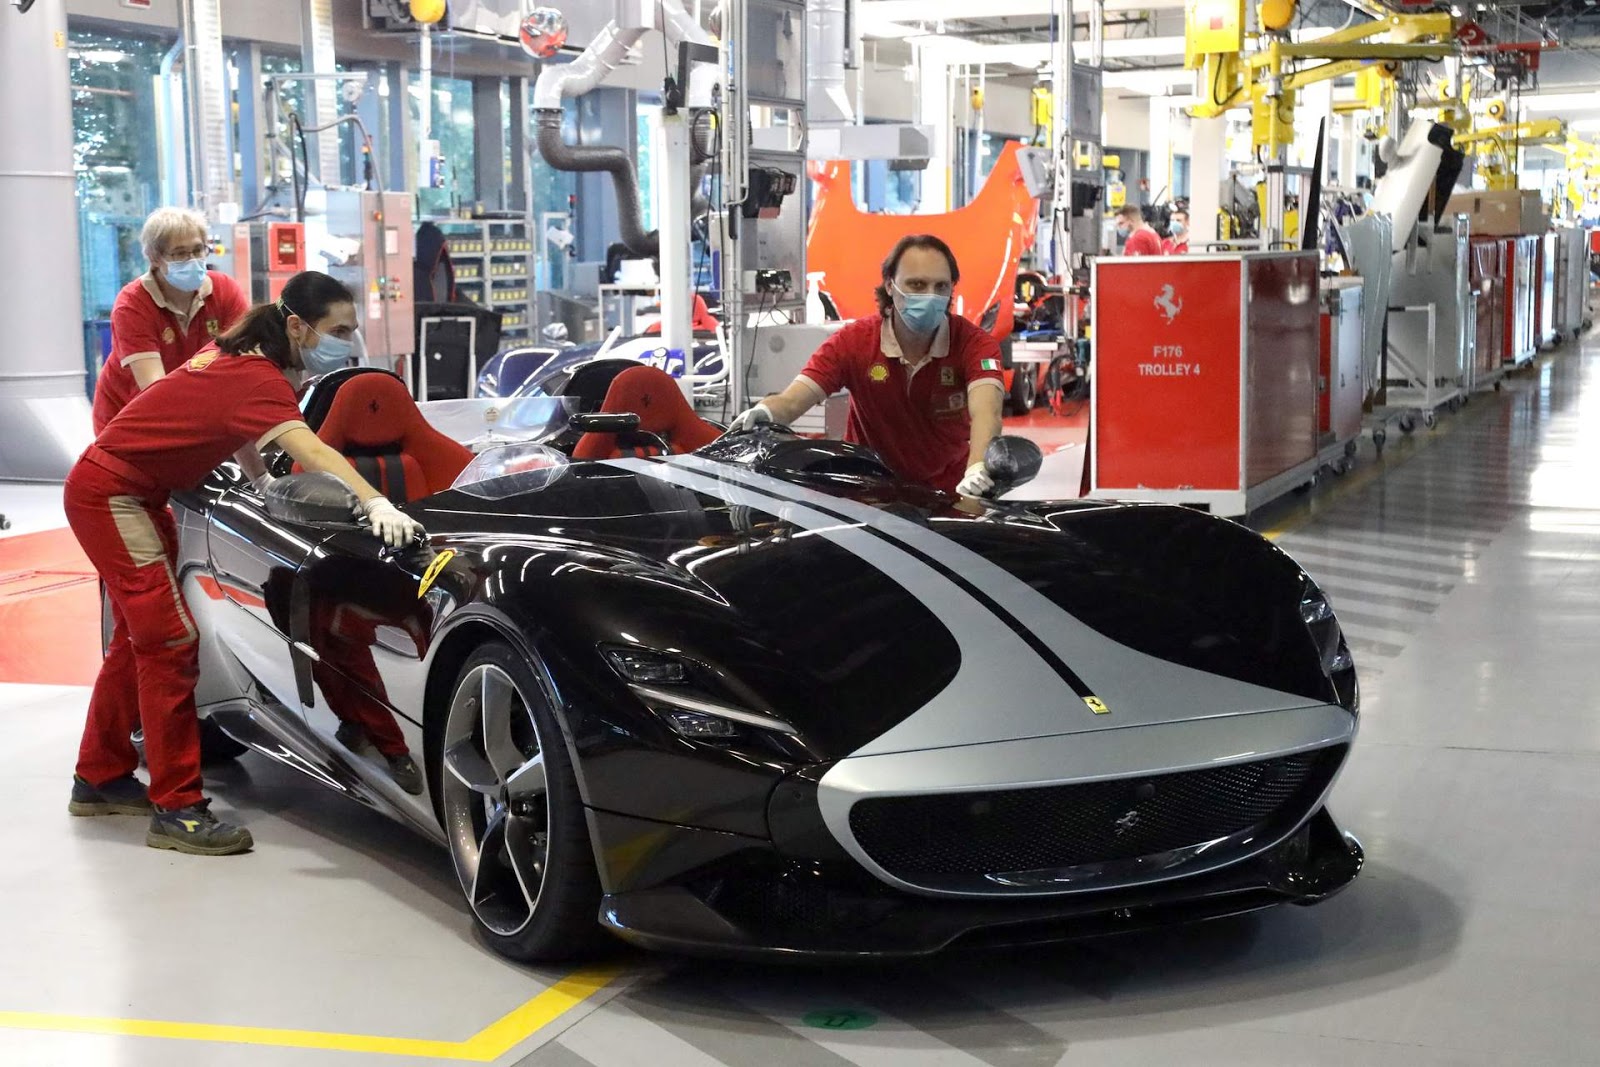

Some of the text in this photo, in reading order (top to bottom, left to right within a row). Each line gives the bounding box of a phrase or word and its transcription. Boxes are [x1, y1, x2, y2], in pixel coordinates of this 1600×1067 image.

[1462, 29, 1477, 45] 2
[1153, 345, 1183, 358] F176
[1138, 363, 1201, 376] TROLLEY 4
